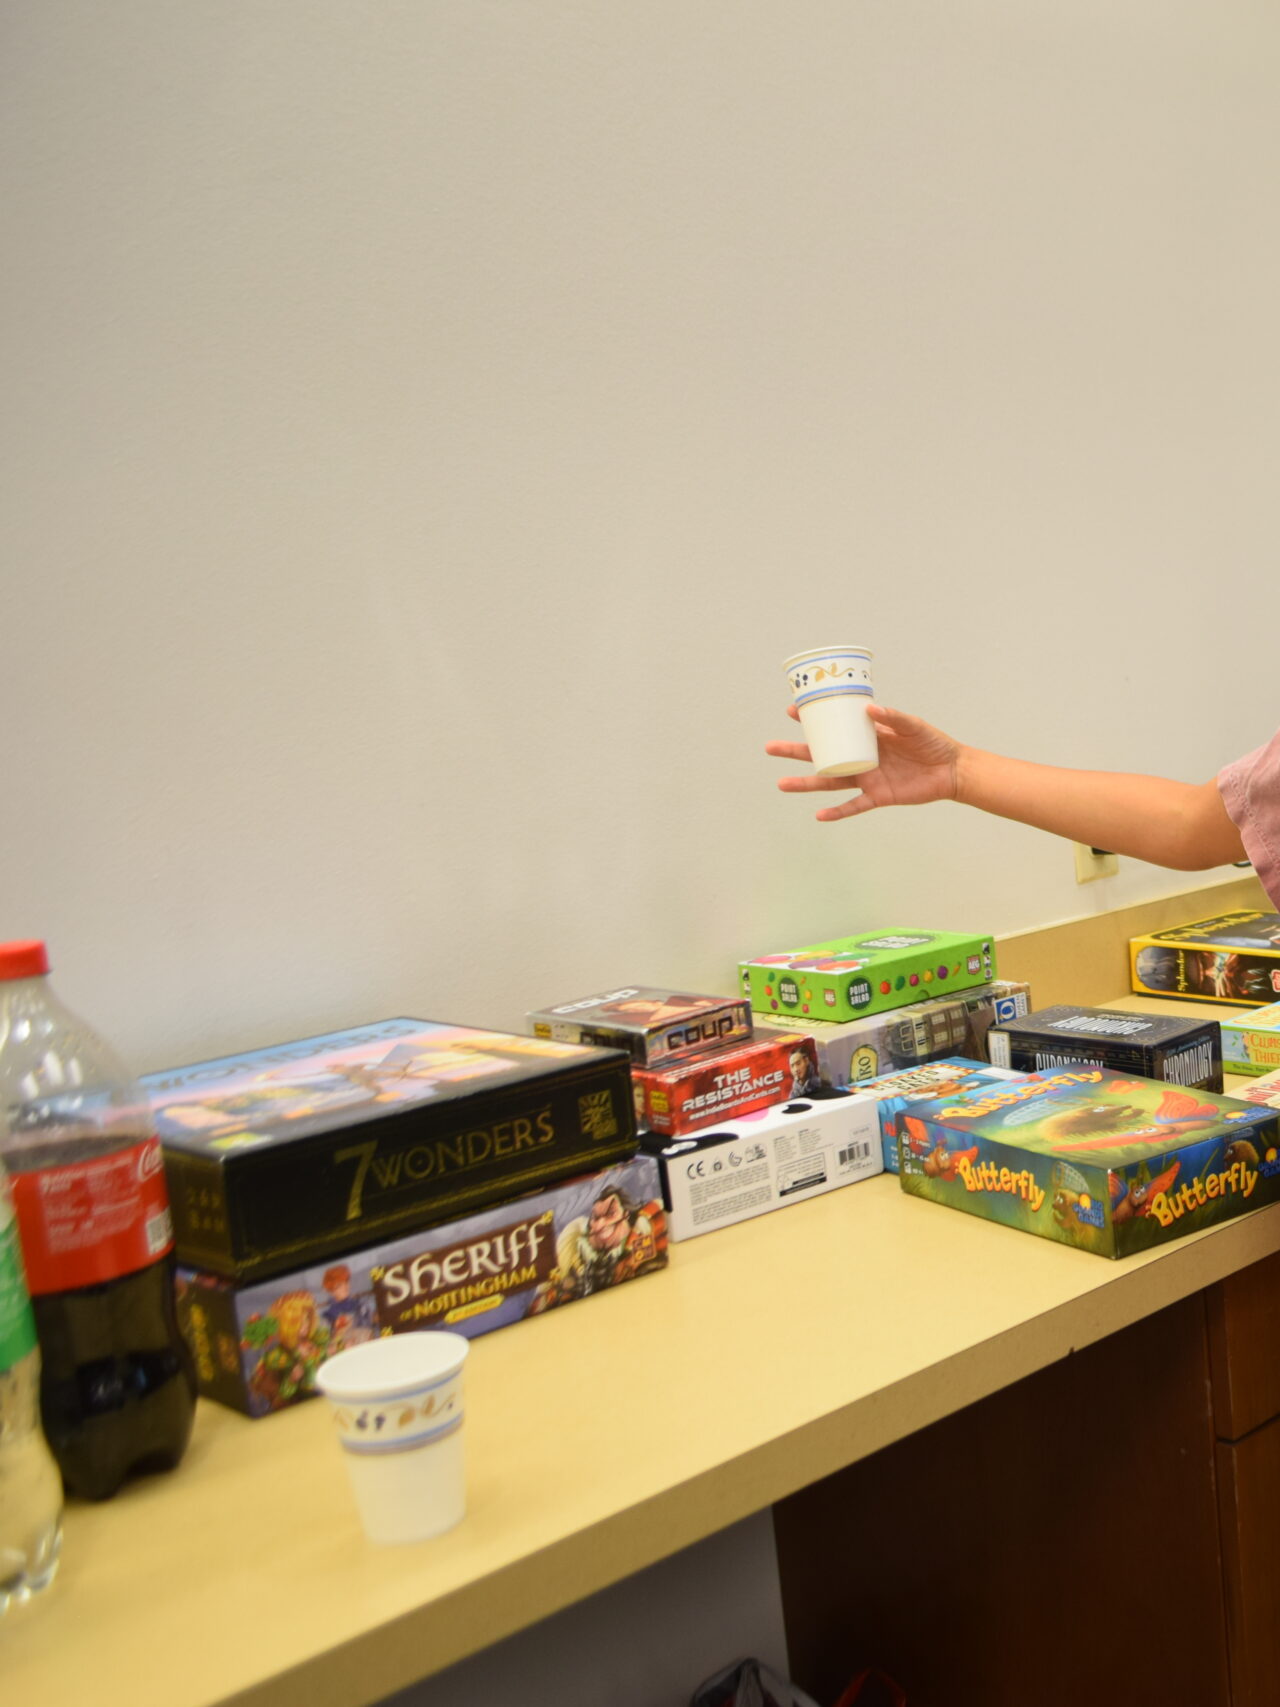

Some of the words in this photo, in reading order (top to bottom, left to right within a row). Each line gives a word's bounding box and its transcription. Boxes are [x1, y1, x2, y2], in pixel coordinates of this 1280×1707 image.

[781, 983, 796, 995] POINT
[782, 993, 798, 1004] SALAD
[850, 982, 868, 996] POINT
[851, 993, 870, 1005] SALAD
[713, 1067, 751, 1089] THE
[857, 1055, 872, 1085] TRO
[1162, 1041, 1214, 1086] CHRONOLOGY
[682, 1070, 784, 1112] RESISTANCE
[938, 1069, 1104, 1120] Butterfly
[334, 1139, 379, 1221] 7
[370, 1110, 555, 1190] WONDERS
[958, 1156, 1046, 1212] Butterfly
[1150, 1161, 1259, 1228] Butterfly
[413, 1265, 538, 1321] NOTTINGHAM
